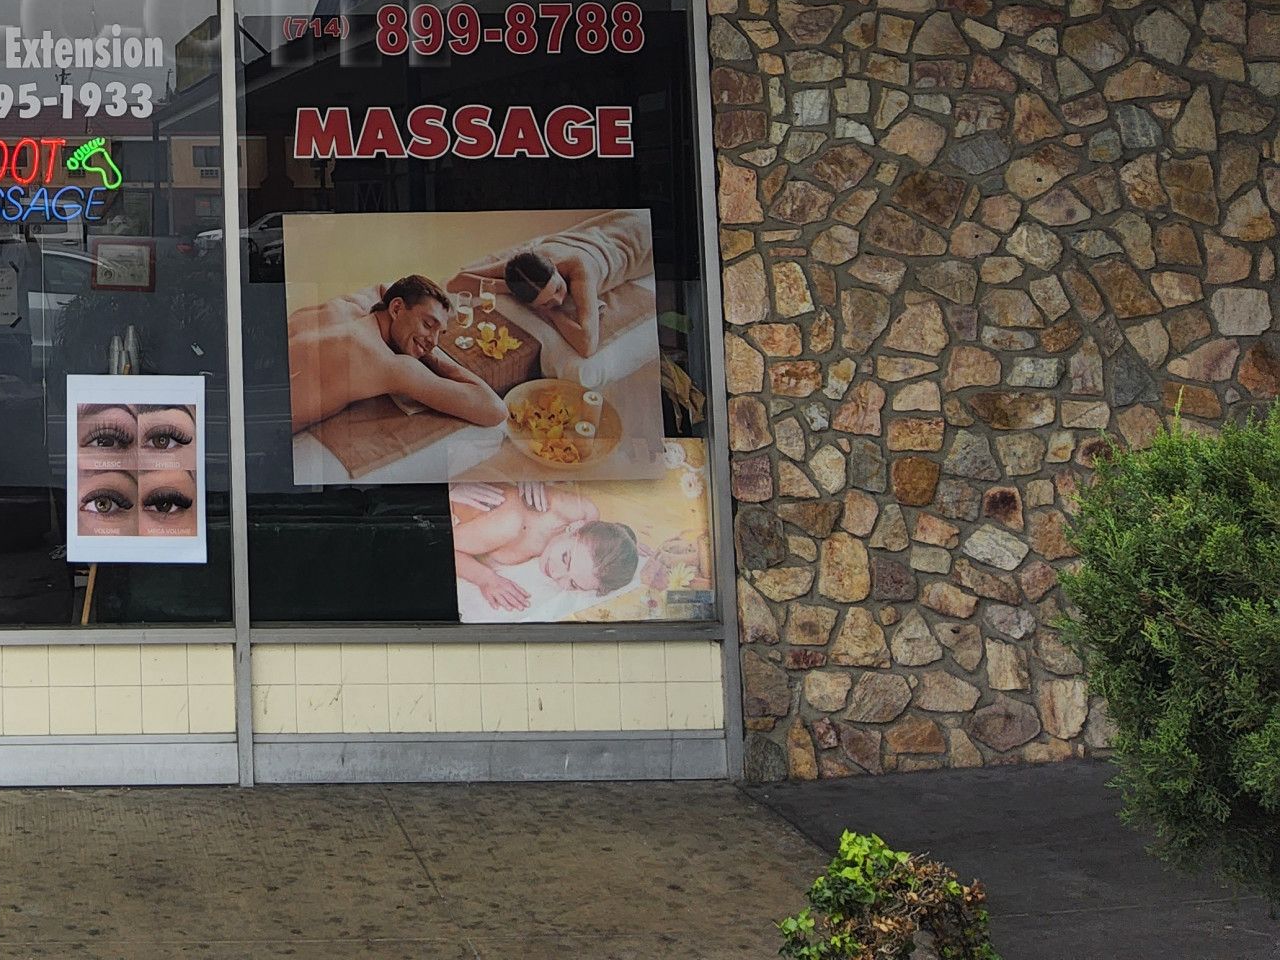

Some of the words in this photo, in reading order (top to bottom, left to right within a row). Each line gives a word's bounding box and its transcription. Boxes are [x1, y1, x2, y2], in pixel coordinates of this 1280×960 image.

[5, 24, 163, 69] Extension
[283, 15, 349, 40] (714)
[375, 1, 645, 54] 899-8788
[294, 104, 635, 159] MASSAGE
